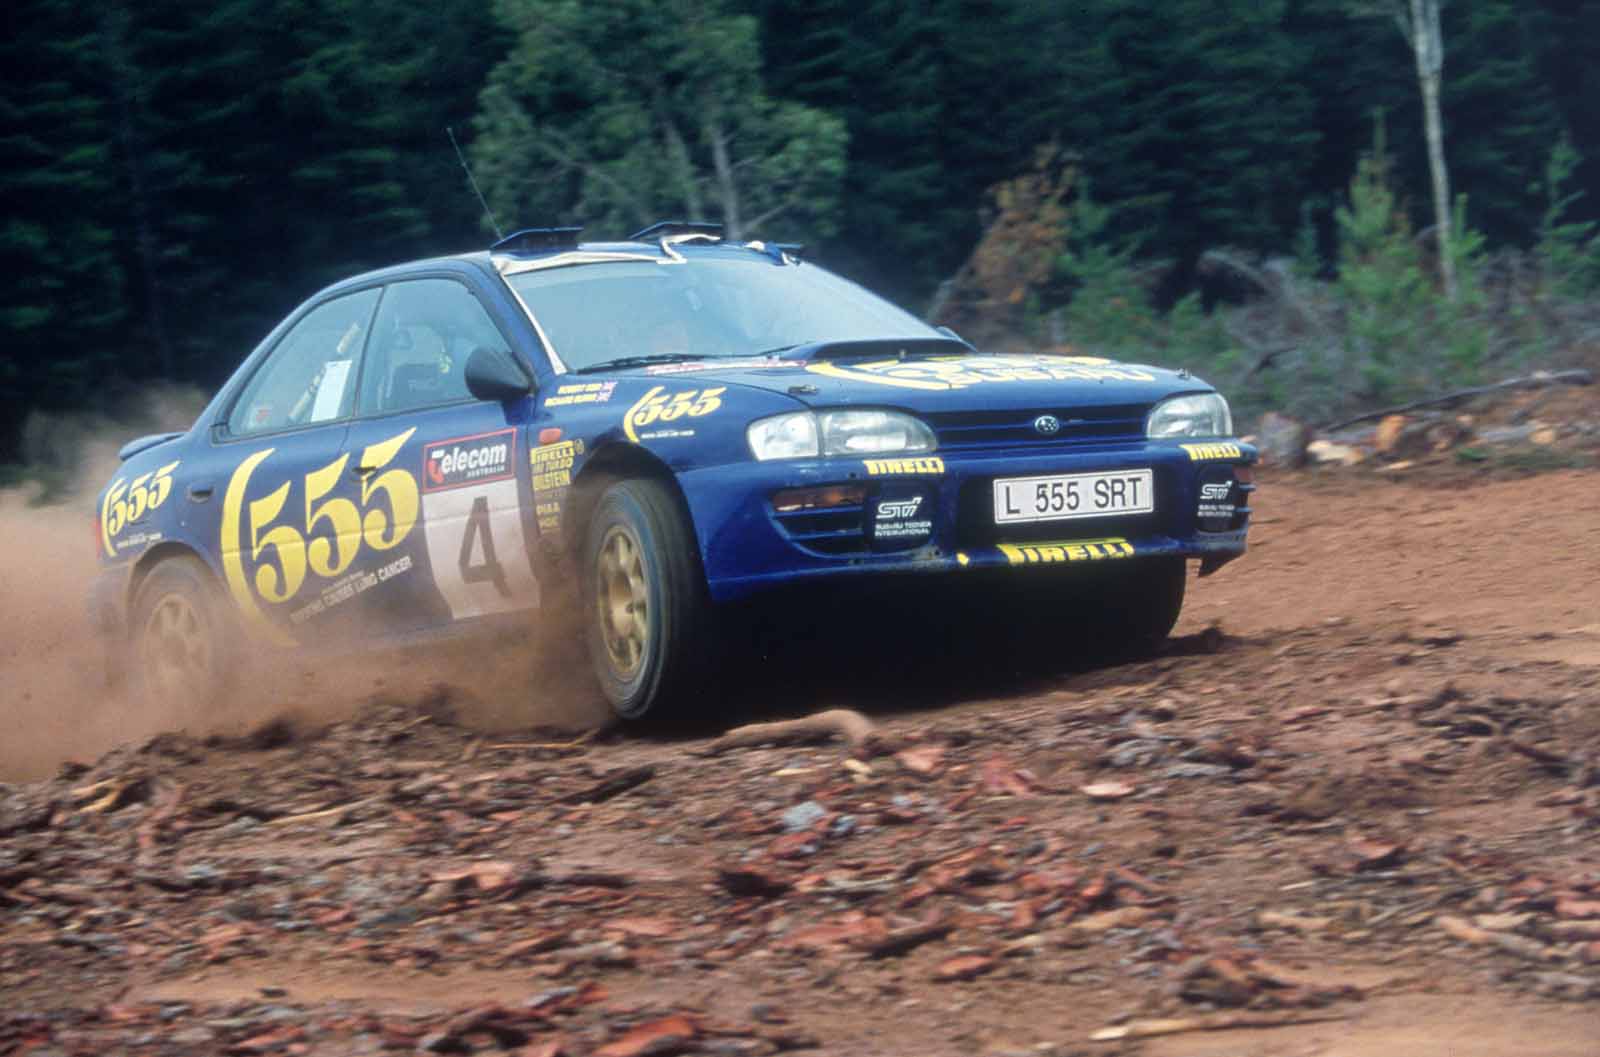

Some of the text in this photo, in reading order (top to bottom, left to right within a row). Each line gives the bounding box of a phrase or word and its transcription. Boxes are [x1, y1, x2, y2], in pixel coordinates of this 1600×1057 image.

[428, 443, 507, 483] Telecom
[863, 457, 945, 474] PIRELLI
[1179, 442, 1242, 460] PIRELLI
[107, 460, 181, 537] 555
[250, 426, 419, 603] 555
[1005, 477, 1142, 514] L 555 SRT
[458, 496, 514, 598] 4
[996, 537, 1136, 564] PIRELLI
